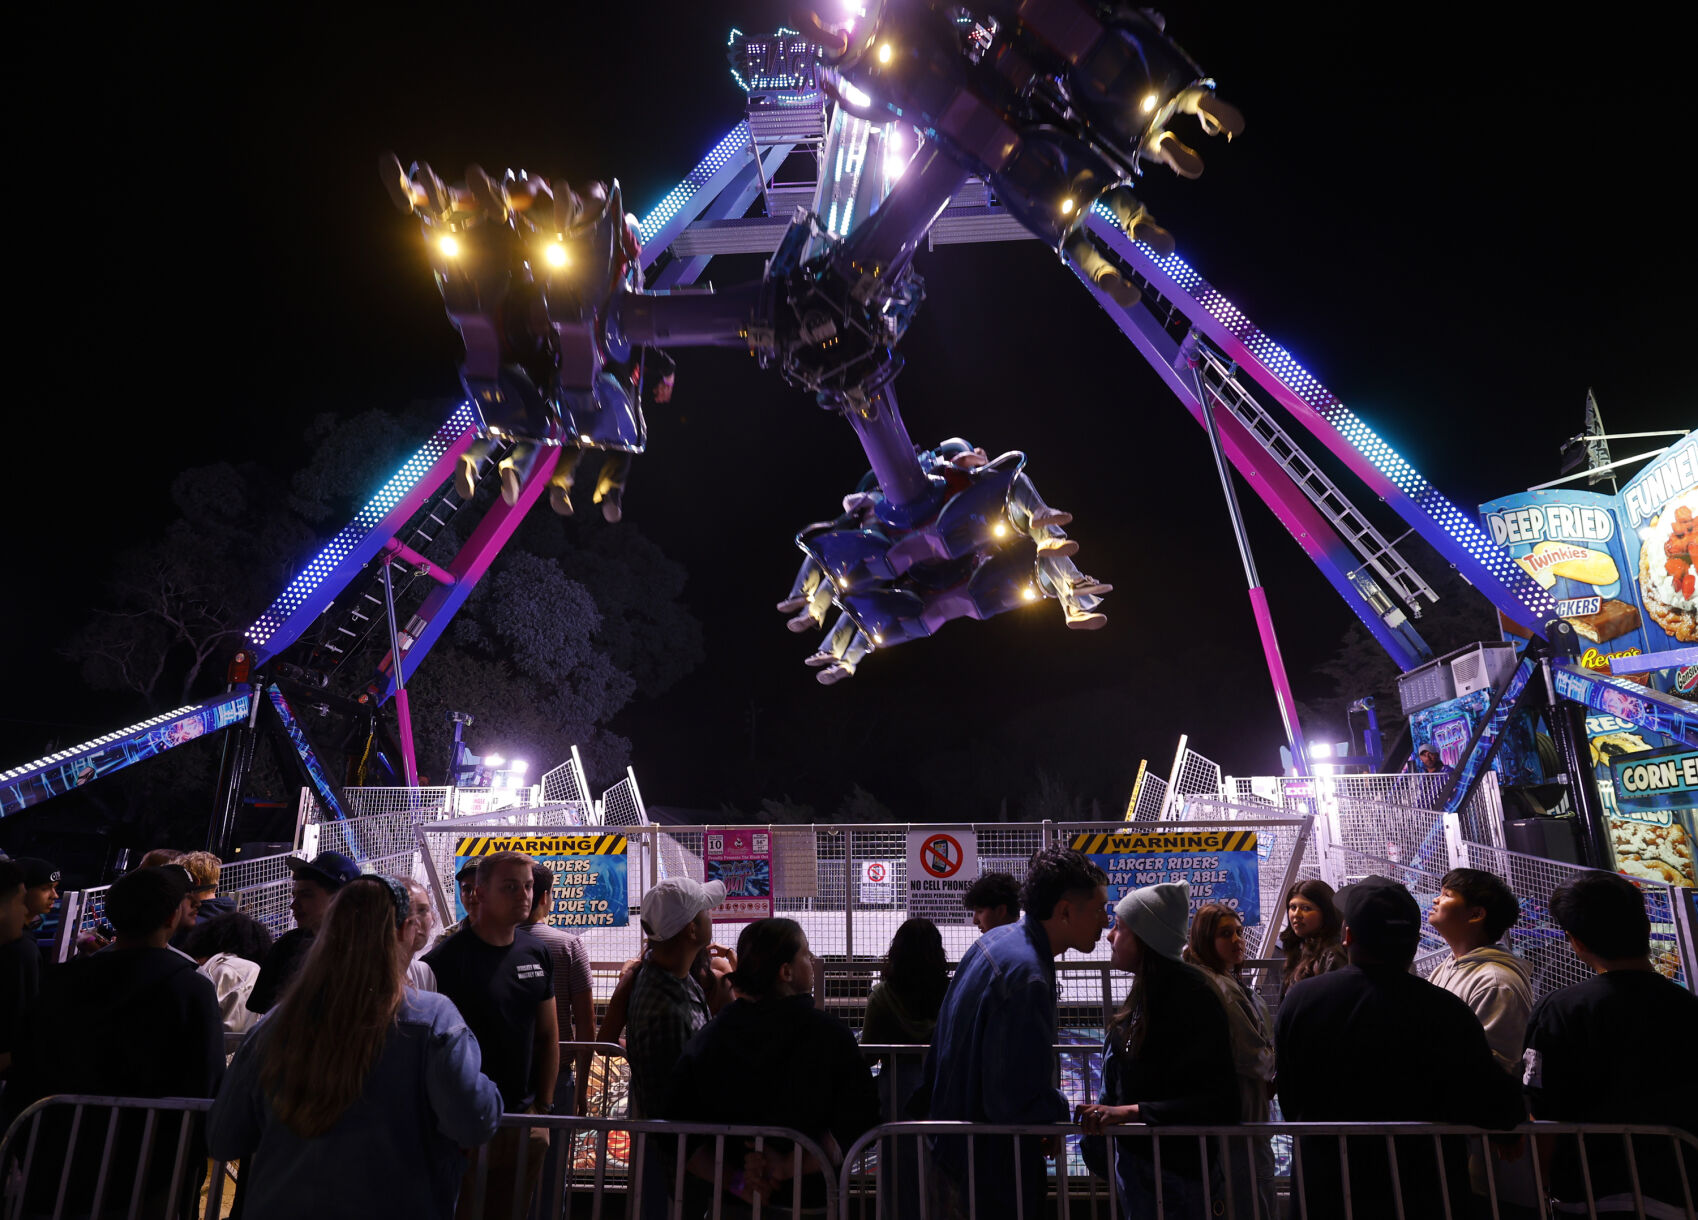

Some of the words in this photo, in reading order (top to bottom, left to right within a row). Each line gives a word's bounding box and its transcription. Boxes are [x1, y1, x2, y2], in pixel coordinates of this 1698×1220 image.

[1490, 507, 1543, 543] DEEP
[1546, 507, 1609, 539] FRIED
[1524, 546, 1588, 571] Twinkies
[1557, 598, 1600, 616] CKERS
[1622, 757, 1698, 793] CORN-E
[492, 840, 594, 852] WARNING
[709, 840, 722, 850] 10
[1111, 835, 1221, 849] WARNING
[1109, 857, 1164, 871] LARGER
[1167, 856, 1219, 870] RIDERS
[564, 872, 599, 885] ABLE
[1135, 871, 1166, 884] NOT
[1169, 871, 1188, 882] BE
[1191, 870, 1228, 883] ABLE
[910, 880, 921, 891] NO
[923, 880, 941, 891] CELL
[942, 880, 973, 891] PHONES
[1190, 884, 1213, 897] HIS
[553, 886, 584, 899] THIS
[558, 900, 586, 912] DUE
[590, 899, 609, 912] TO
